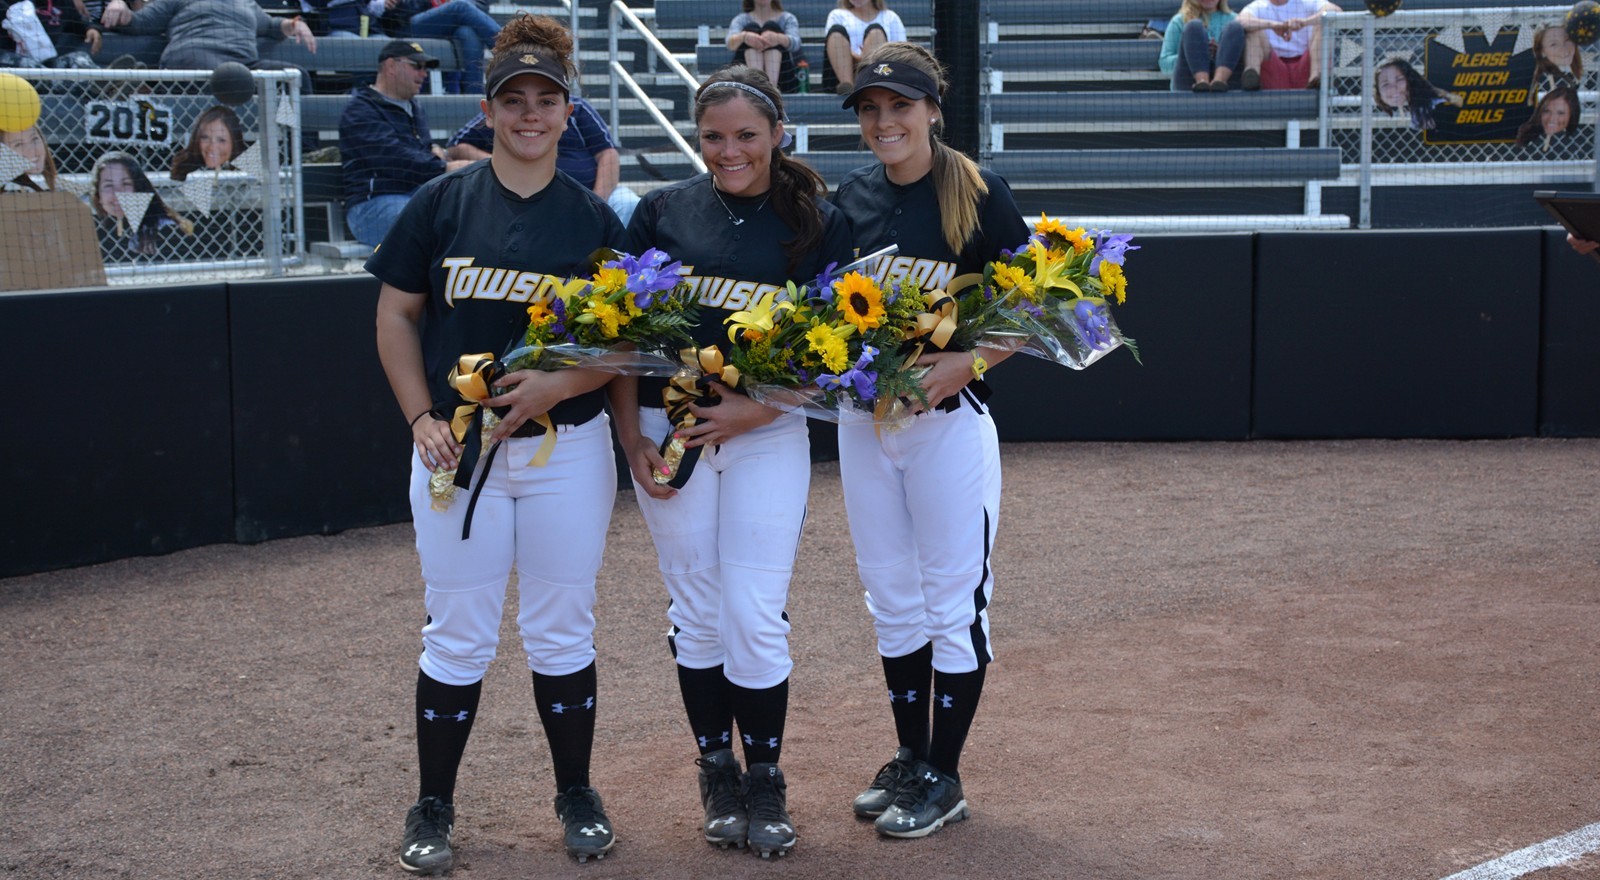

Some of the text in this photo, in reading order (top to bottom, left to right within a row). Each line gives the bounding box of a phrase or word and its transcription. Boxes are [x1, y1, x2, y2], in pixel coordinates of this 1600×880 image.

[1452, 52, 1511, 68] PLEASE
[1453, 71, 1510, 86] WATCH
[1466, 89, 1528, 105] BATTED
[90, 100, 169, 142] 2015
[1456, 109, 1504, 124] BALLS
[442, 257, 566, 309] TOWSO
